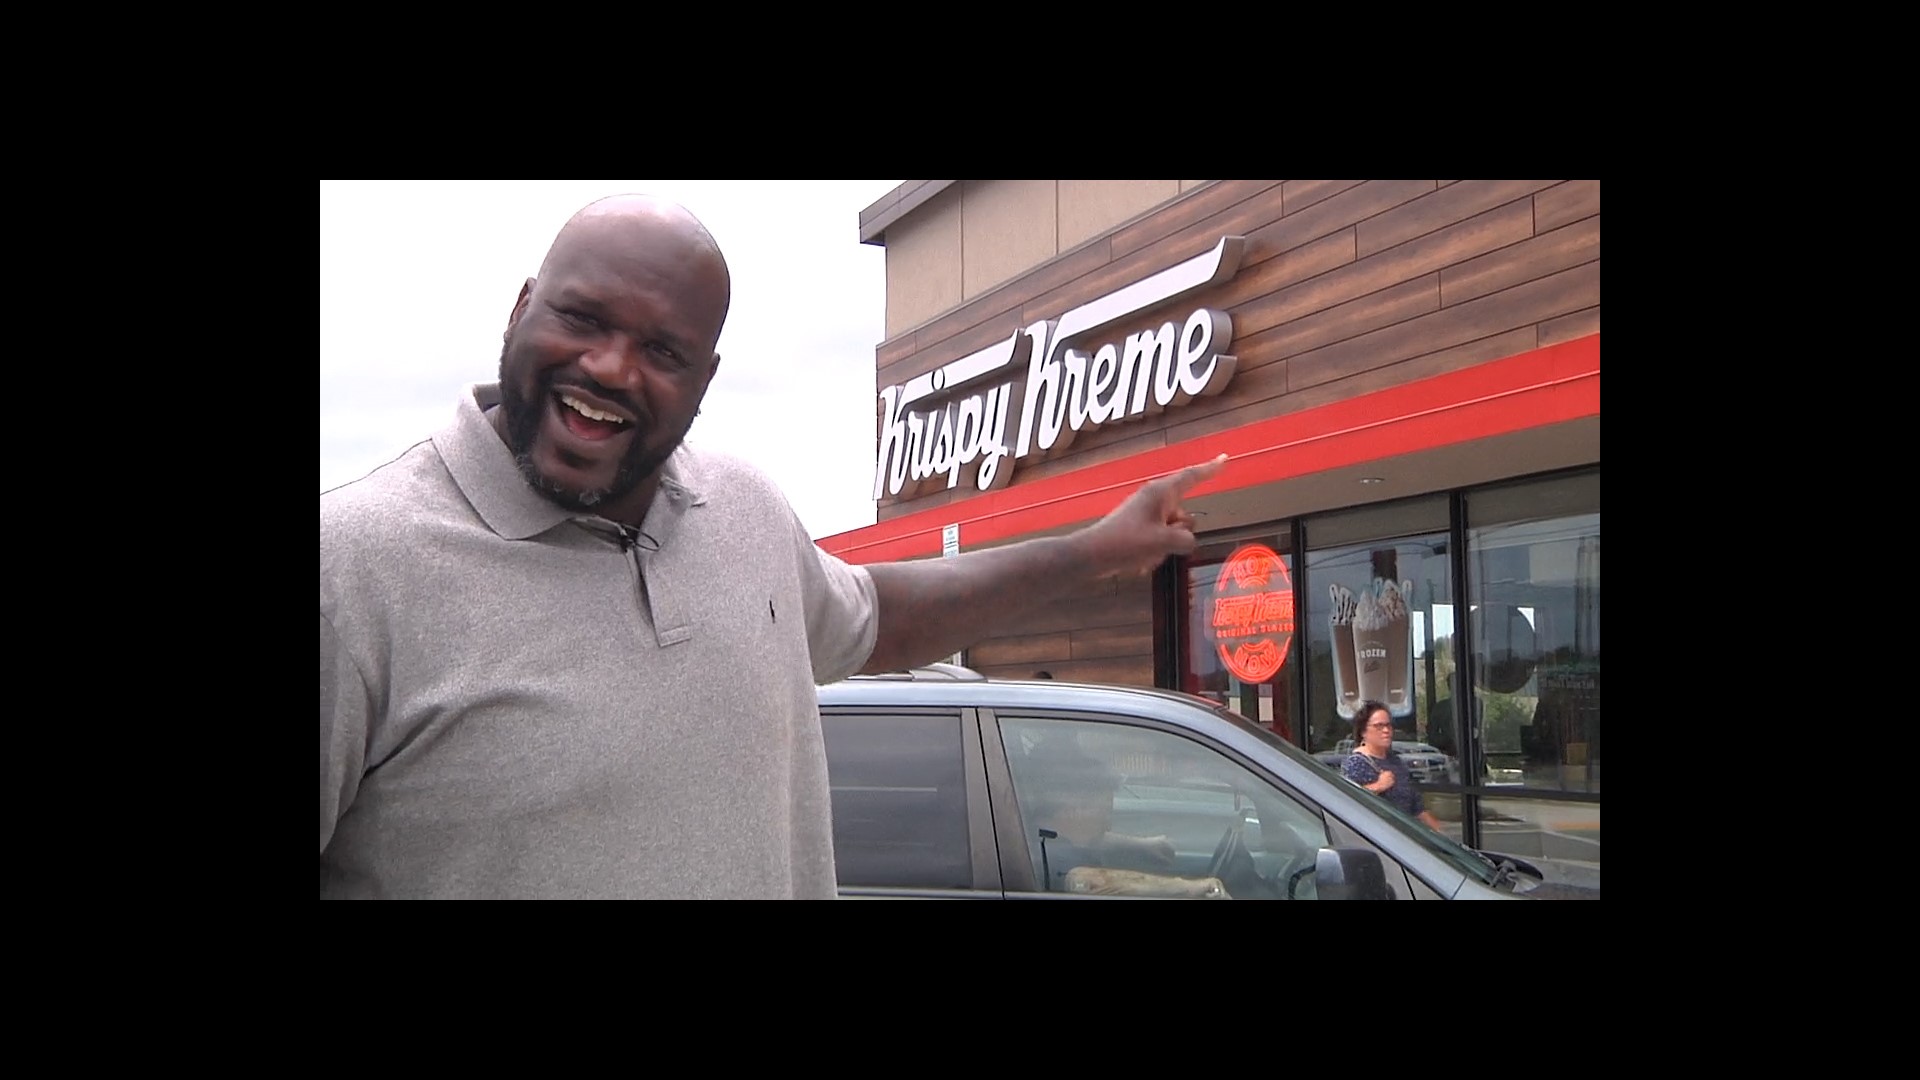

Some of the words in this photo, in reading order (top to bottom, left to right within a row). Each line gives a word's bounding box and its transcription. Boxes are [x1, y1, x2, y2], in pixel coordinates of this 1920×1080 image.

[873, 329, 1020, 499] Krispy
[1015, 236, 1234, 458] Kreme
[1233, 556, 1272, 586] HOT
[1253, 590, 1293, 623] Krem
[1233, 641, 1277, 675] NOW
